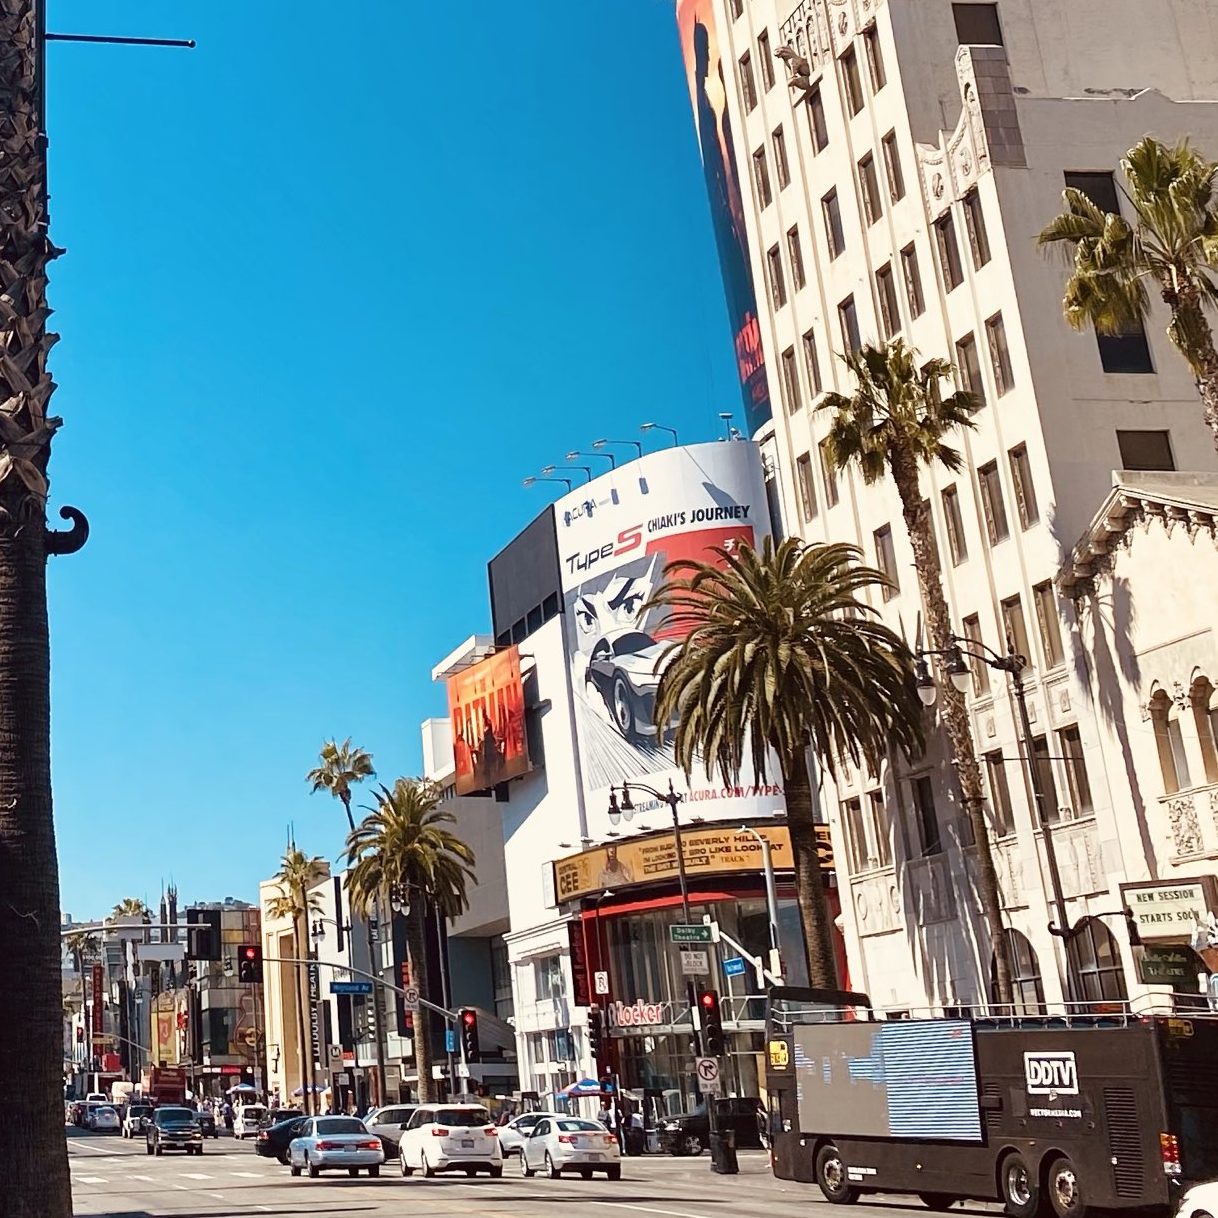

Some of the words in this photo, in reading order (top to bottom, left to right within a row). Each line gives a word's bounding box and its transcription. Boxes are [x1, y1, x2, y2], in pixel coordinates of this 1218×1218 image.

[647, 512, 686, 533] CHIAKI'S
[690, 505, 751, 524] JOURNEY
[689, 784, 786, 802] ACURA.COM/TYPE-
[689, 836, 730, 847] BEVERLY
[709, 845, 732, 854] LIKE
[560, 871, 579, 895] CEE
[1136, 892, 1154, 903] NEW
[1158, 889, 1195, 901] SESSION
[1139, 912, 1173, 924] STARTS
[676, 927, 696, 935] Dolby
[616, 999, 662, 1027] Locker
[1027, 1060, 1073, 1086] DDTV
